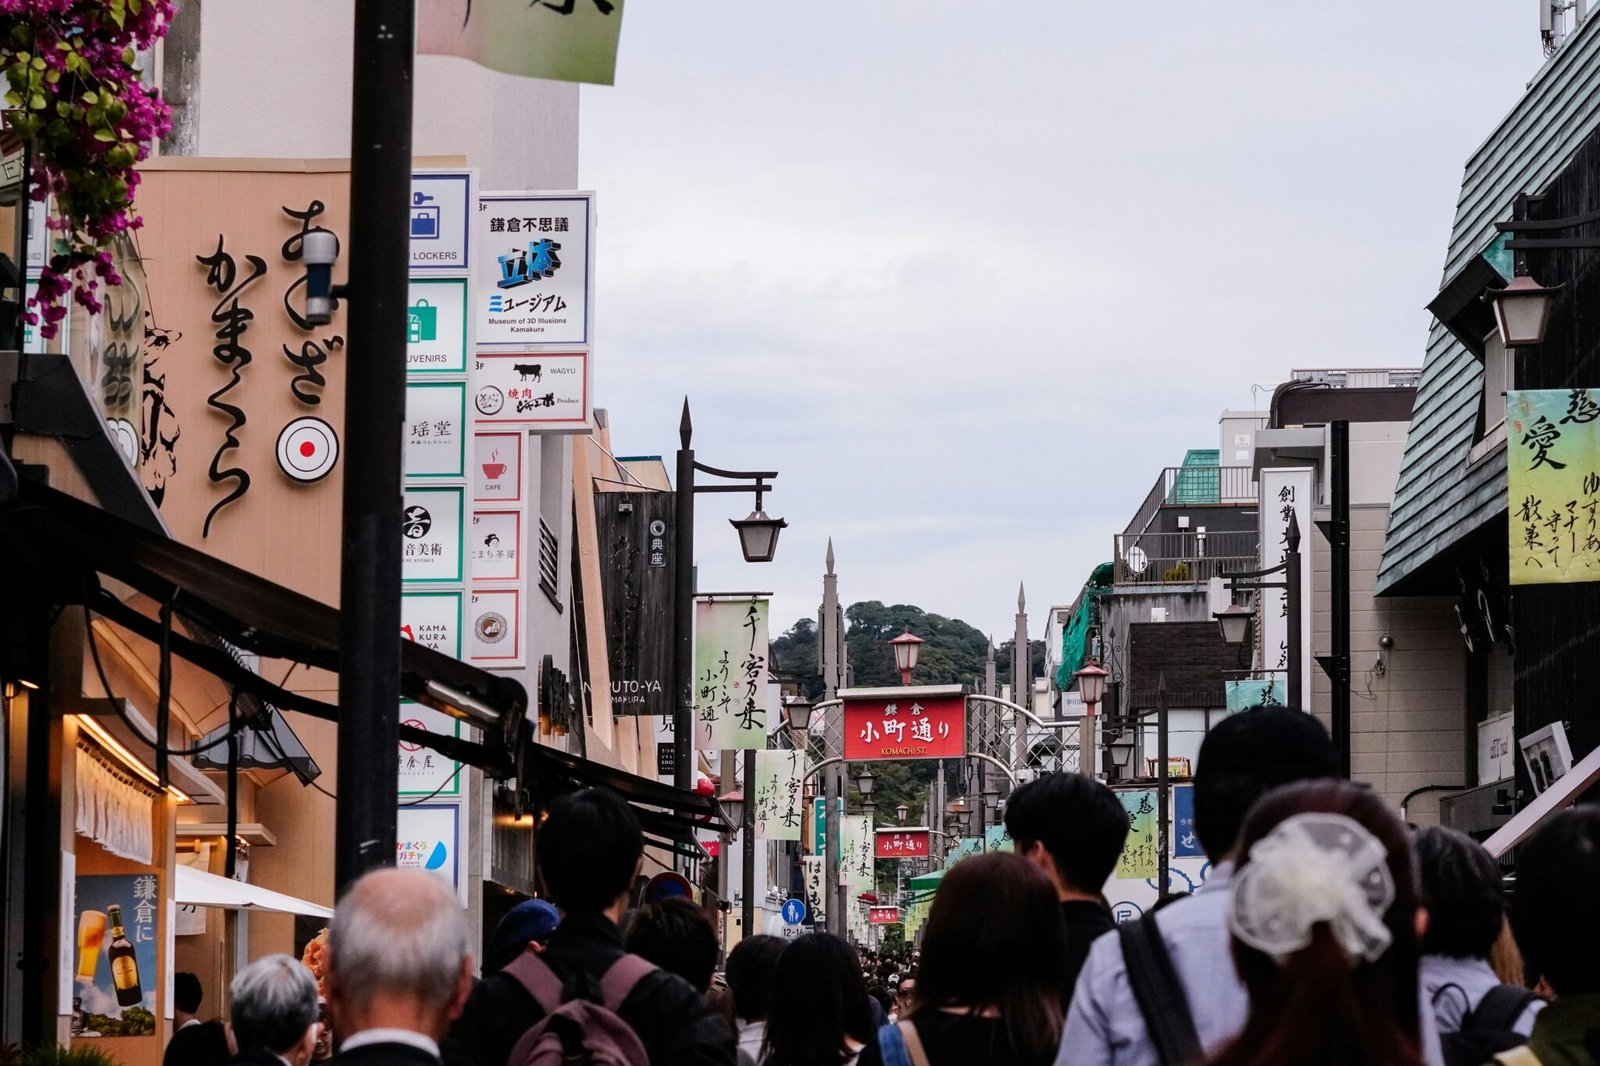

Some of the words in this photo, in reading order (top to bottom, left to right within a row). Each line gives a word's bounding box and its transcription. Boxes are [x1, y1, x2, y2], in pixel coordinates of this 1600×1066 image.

[490, 217, 569, 233] 鎌倉不思議
[413, 251, 457, 260] LOCKERS
[497, 238, 561, 289] 立体
[488, 293, 567, 313] ミュージアム
[488, 317, 517, 325] Museum
[518, 317, 525, 325] of
[526, 317, 536, 325] 3D
[538, 317, 567, 325] Illusions
[406, 354, 447, 363] UVENIRS
[550, 367, 576, 375] WAGYU
[196, 233, 267, 539] かまくら
[508, 388, 532, 399] 焼肉
[1521, 415, 1567, 471] 愛
[1514, 494, 1544, 568] 散策へ
[1563, 500, 1579, 553] マナー
[1543, 509, 1562, 568] 守って
[651, 537, 666, 565] 典座
[419, 633, 447, 641] KURA
[734, 605, 766, 730] 千客万来
[609, 680, 662, 693] UTO-YA
[717, 650, 732, 714] ようこそ
[700, 669, 719, 742] 小町通り
[884, 703, 924, 716] 鎌倉
[860, 717, 949, 743] 小町通り
[881, 747, 916, 755] KOMACHI
[397, 755, 435, 770] 倉屋
[883, 840, 922, 851] 小町通り
[133, 875, 158, 943] 鎌倉に
